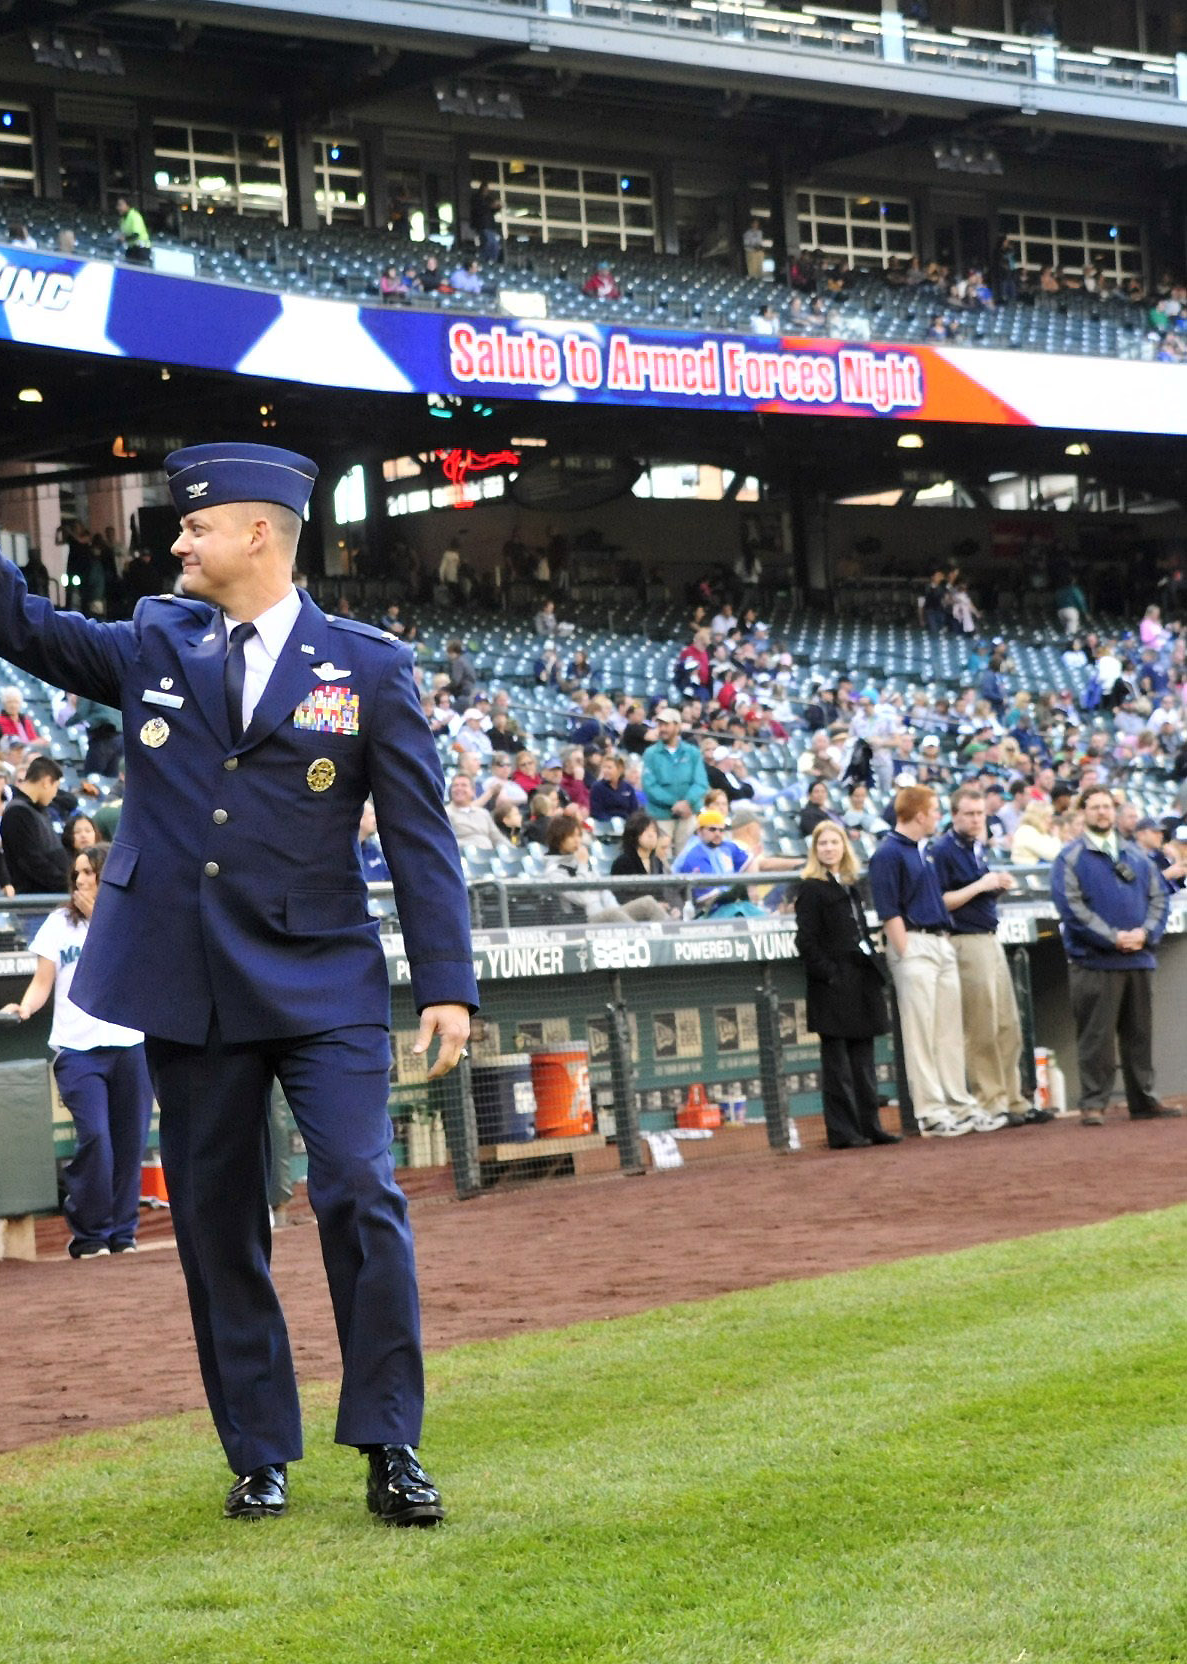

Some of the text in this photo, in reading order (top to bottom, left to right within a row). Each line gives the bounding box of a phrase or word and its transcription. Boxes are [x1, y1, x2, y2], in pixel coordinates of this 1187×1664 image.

[450, 323, 923, 412] Salute to Armed Forces Night
[486, 945, 564, 979] YUNKER
[674, 940, 733, 961] POWERED
[749, 931, 800, 961] YUNK
